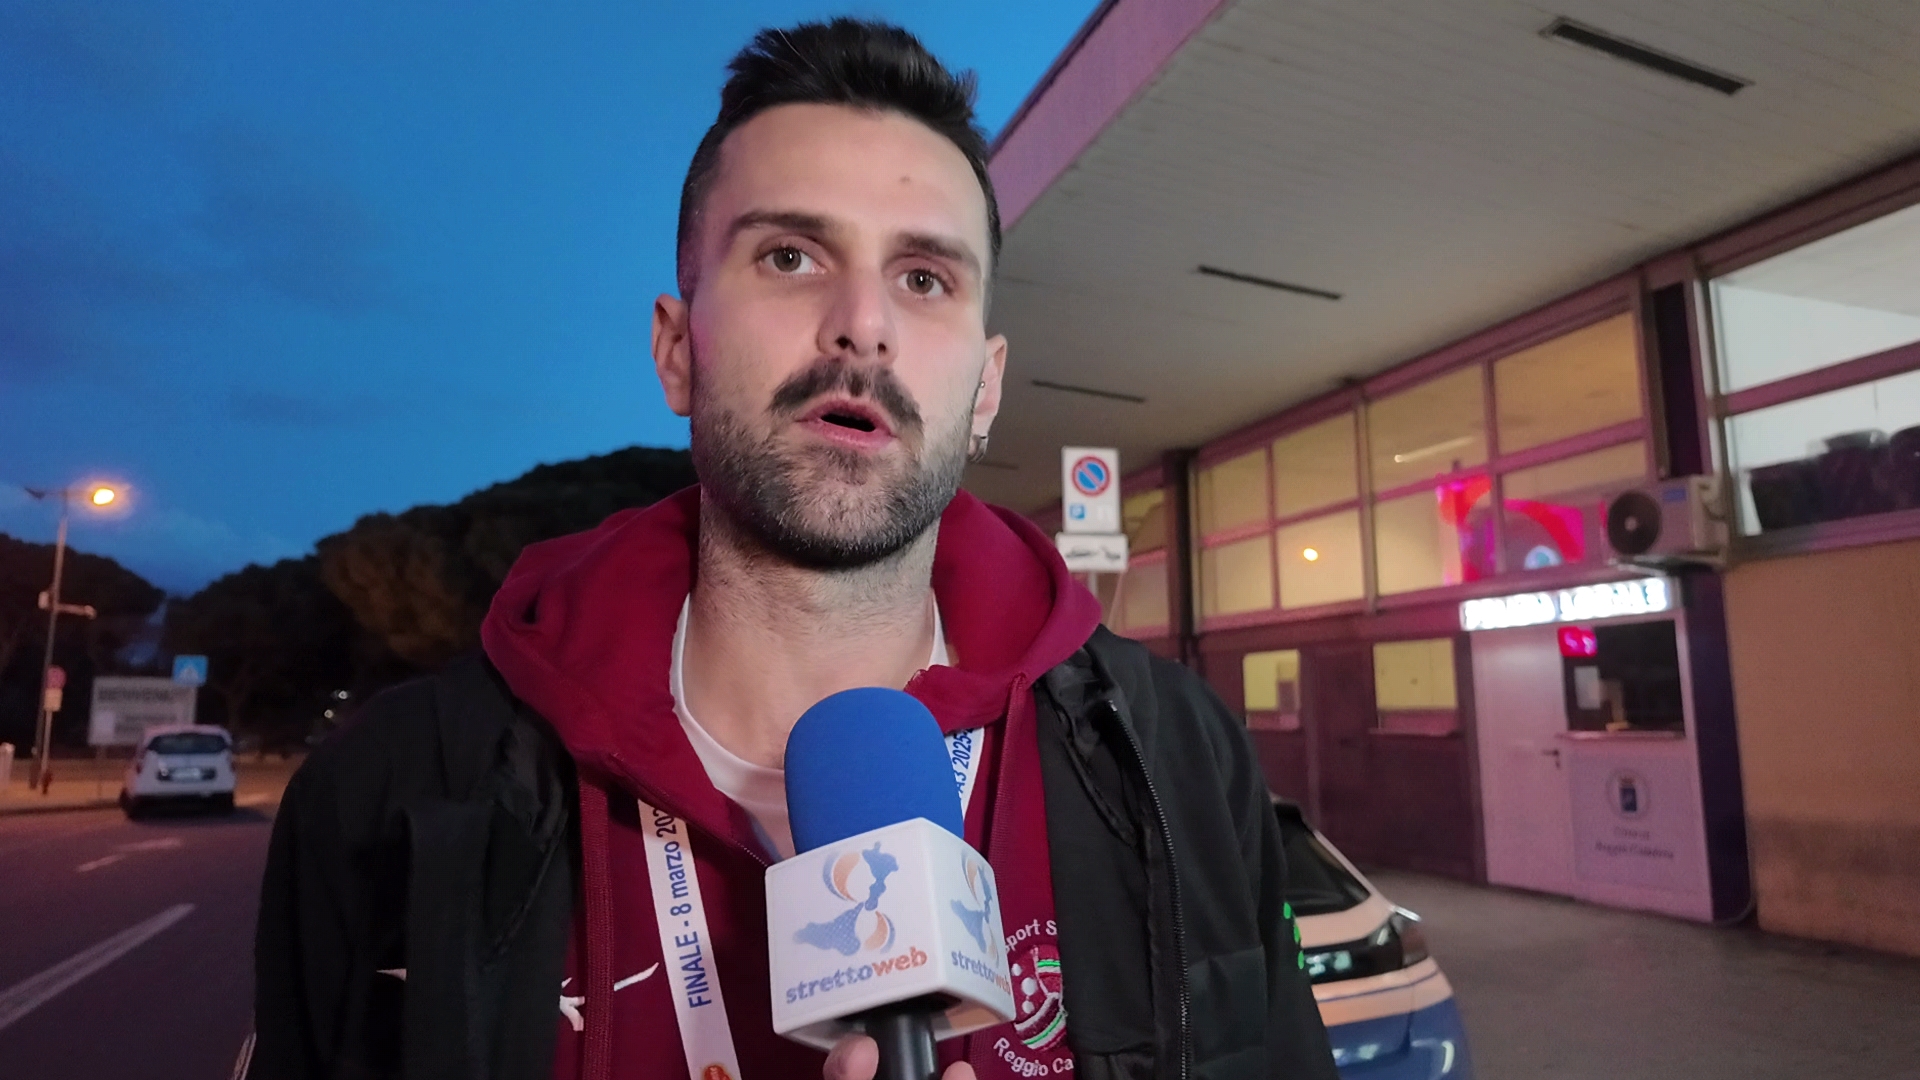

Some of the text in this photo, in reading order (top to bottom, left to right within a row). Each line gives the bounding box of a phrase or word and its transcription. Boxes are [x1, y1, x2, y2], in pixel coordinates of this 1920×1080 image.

[663, 841, 689, 899] marzo
[671, 903, 692, 916] 8
[675, 930, 713, 1008] FINALE
[785, 945, 928, 1004] strettoweb
[950, 949, 1012, 994] strettoweb
[993, 1037, 1049, 1077] Reggio
